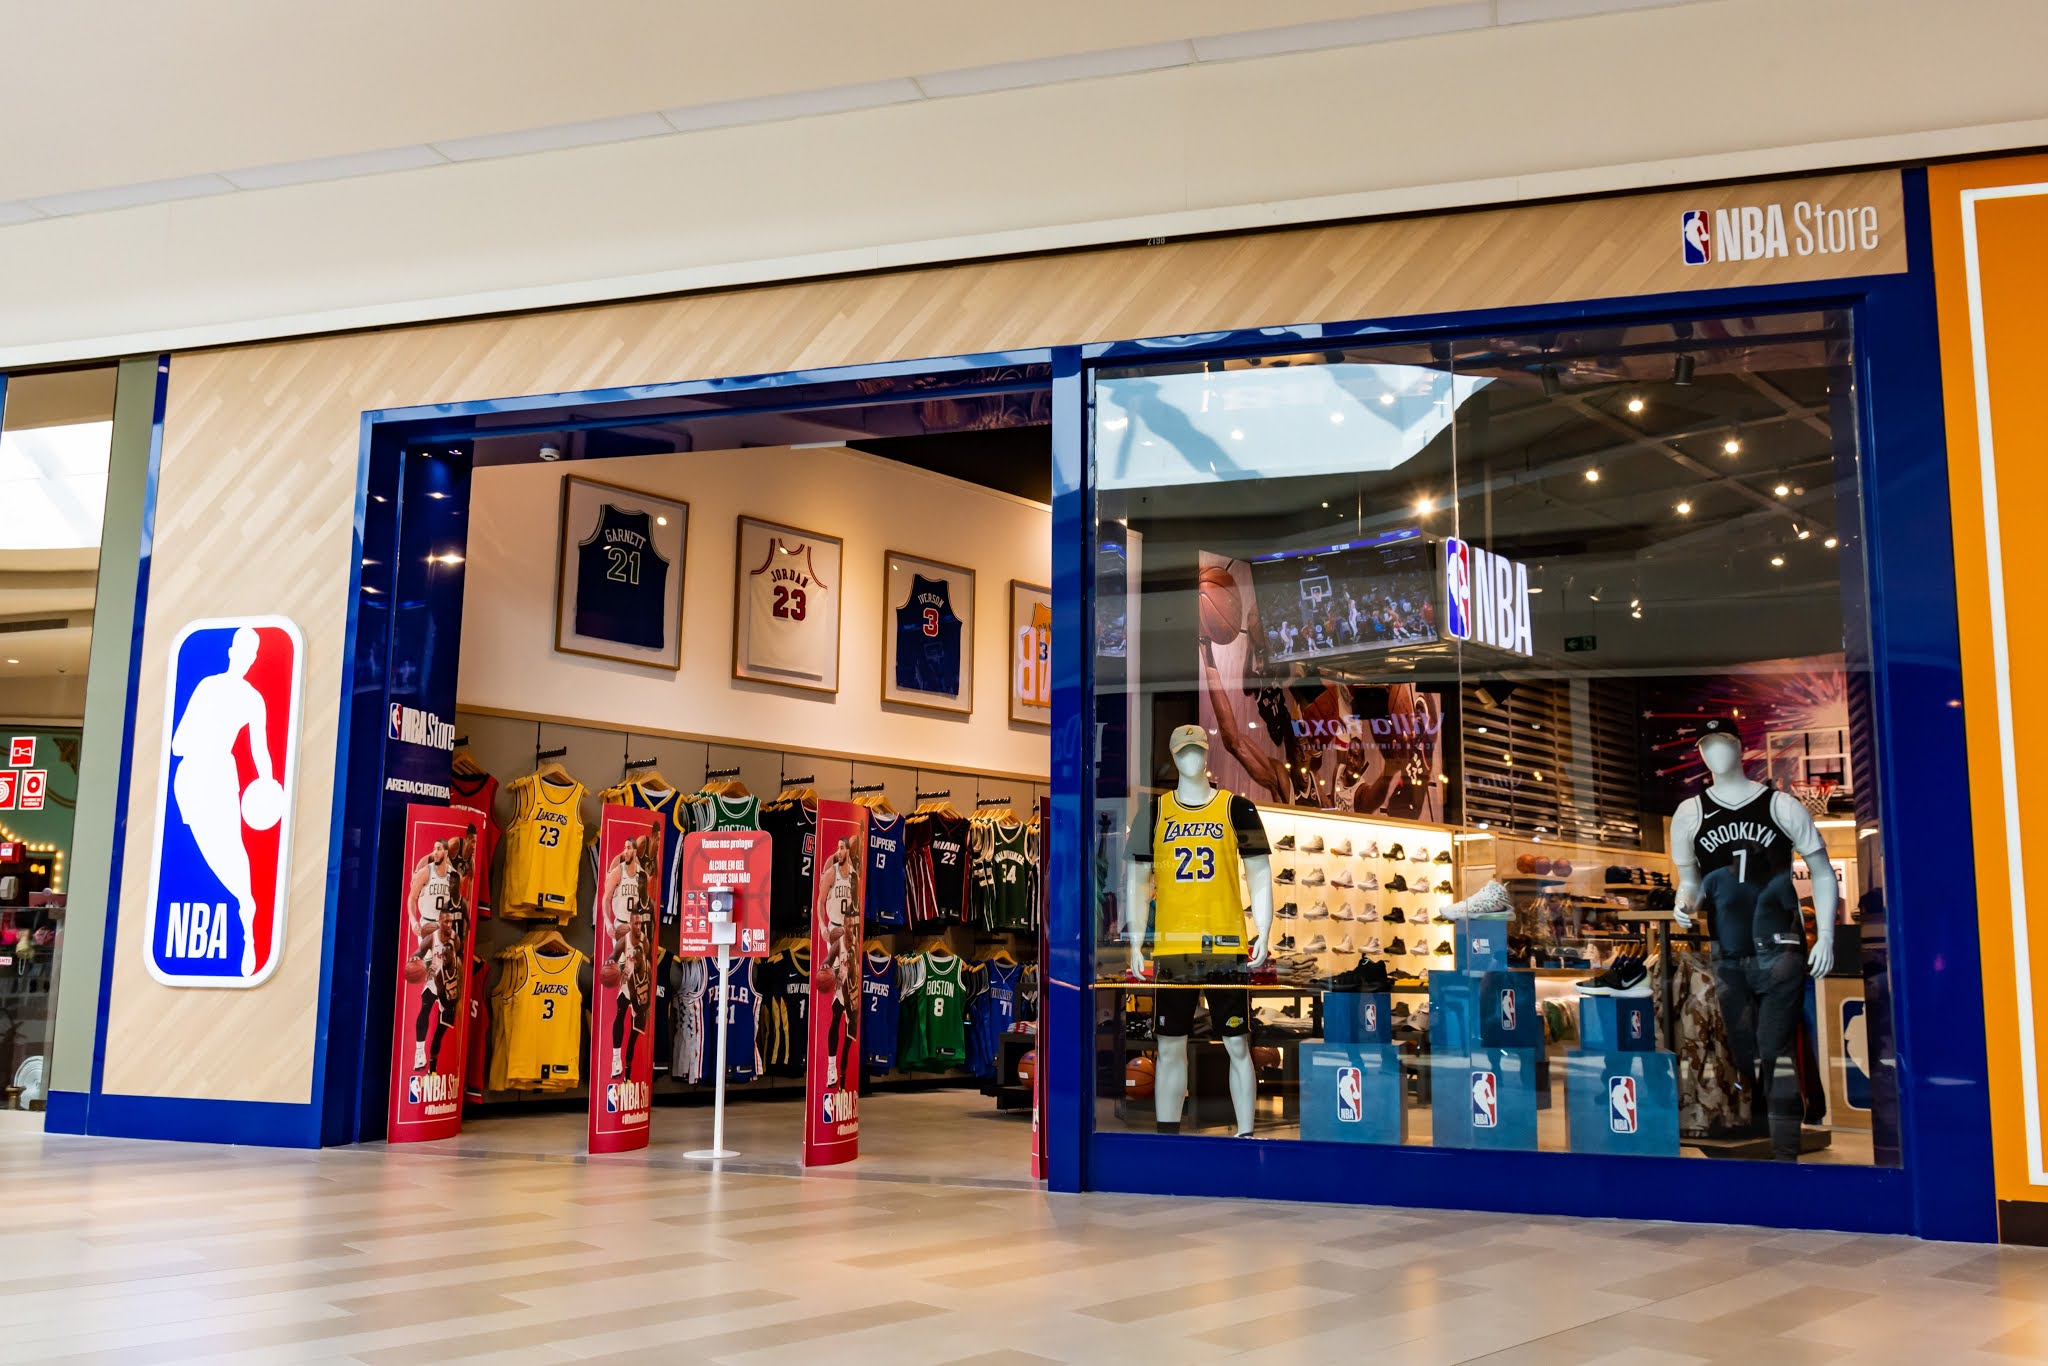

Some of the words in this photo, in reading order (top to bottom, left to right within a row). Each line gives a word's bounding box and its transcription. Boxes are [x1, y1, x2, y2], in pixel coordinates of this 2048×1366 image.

[1716, 204, 1789, 262] NBA
[1793, 201, 1878, 256] Store
[605, 528, 647, 549] GARNETT
[607, 547, 640, 585] 21
[771, 568, 809, 588] JORDAN
[773, 585, 807, 621] 23
[917, 593, 945, 608] IVERSON
[1475, 547, 1533, 656] NBA
[923, 607, 939, 638] 3
[401, 706, 427, 746] NBA
[427, 712, 455, 751] Store
[534, 807, 568, 825] LAKERS
[539, 825, 560, 848] 23
[1162, 820, 1224, 843] LAKERS
[1699, 821, 1777, 853] BROOKLYN
[702, 838, 719, 849] Vamos
[801, 857, 811, 877] 2
[876, 852, 886, 869] 13
[940, 851, 957, 865] 22
[1174, 845, 1215, 883] 23
[1732, 848, 1747, 883] 7
[165, 902, 227, 959] NBA
[752, 929, 765, 940] NBA
[752, 941, 766, 951] Store
[532, 981, 569, 996] LAKERS
[708, 985, 749, 1004] PHLA
[862, 980, 889, 997] CLIPPERS
[926, 980, 955, 998] BOSTON
[542, 998, 555, 1021] 3
[870, 996, 878, 1012] 2
[933, 997, 945, 1017] 8
[423, 1074, 447, 1102] NBA
[620, 1082, 640, 1111] NBA
[836, 1091, 852, 1121] NBA
